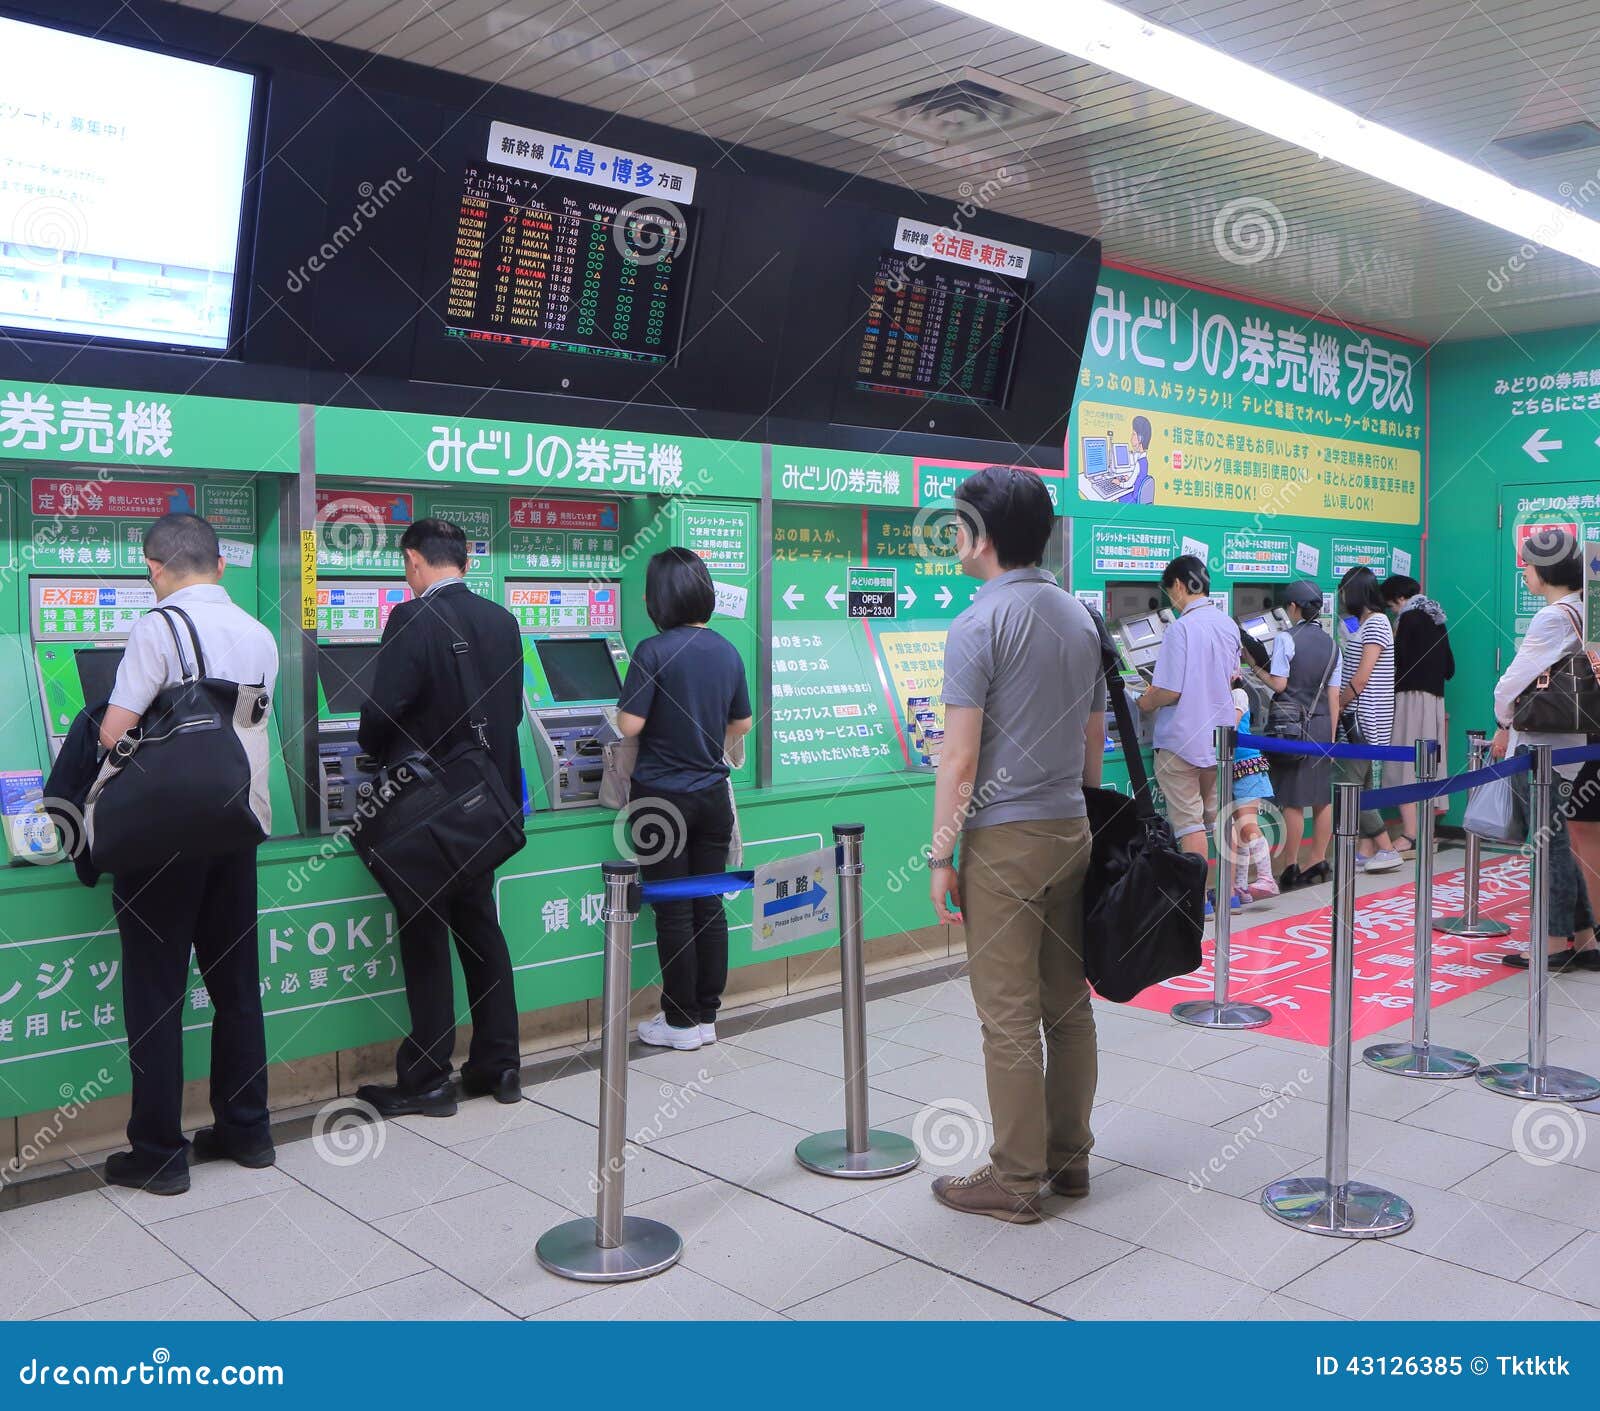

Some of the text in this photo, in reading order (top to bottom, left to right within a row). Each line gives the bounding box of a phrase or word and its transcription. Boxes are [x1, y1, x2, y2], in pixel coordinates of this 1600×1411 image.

[501, 136, 683, 192] 新幹線 広島・博多 方面
[466, 186, 489, 198] Train
[488, 172, 538, 190] HAKATA
[461, 208, 487, 218] HIKARI
[522, 219, 553, 231] OKAYAMA
[462, 198, 488, 208] NOZOMI
[526, 210, 552, 221] HAKATA
[458, 227, 485, 238] NOZOMI
[522, 239, 548, 250] HAKATA
[460, 218, 486, 229] NOZOMI
[523, 229, 549, 240] HAKATA
[457, 237, 483, 249] NOZOMI
[901, 229, 929, 246] 新幹線
[932, 232, 1008, 268] 名古屋・東京
[1008, 254, 1024, 269] 方面
[454, 258, 480, 268] HIKARI
[515, 267, 546, 279] OKAYAMA
[456, 248, 482, 258] NOZOMI
[519, 259, 545, 270] HAKATA
[451, 277, 478, 288] NOZOMI
[515, 287, 541, 298] HAKATA
[453, 268, 479, 279] NOZOMI
[516, 277, 542, 289] HAKATA
[449, 297, 475, 308] NOZOMI
[512, 307, 538, 318] HAKATA
[450, 287, 477, 298] NOZOMI
[513, 297, 540, 308] HAKATA
[447, 307, 475, 318] NOZOMI
[510, 316, 537, 327] HAKATA
[1091, 285, 1414, 415] みどりの券売機 プラス
[0, 391, 173, 458] 券売機
[427, 426, 683, 488] みどりの券売機
[782, 464, 900, 495] みどりの券売機
[58, 547, 112, 564] 特急券
[527, 554, 562, 568] 特急券
[303, 531, 316, 628] 防犯カメラ 作動中
[862, 594, 883, 604] OPEN
[780, 743, 890, 766] ご予約いただいたきっぷ
[776, 875, 808, 899] 順路
